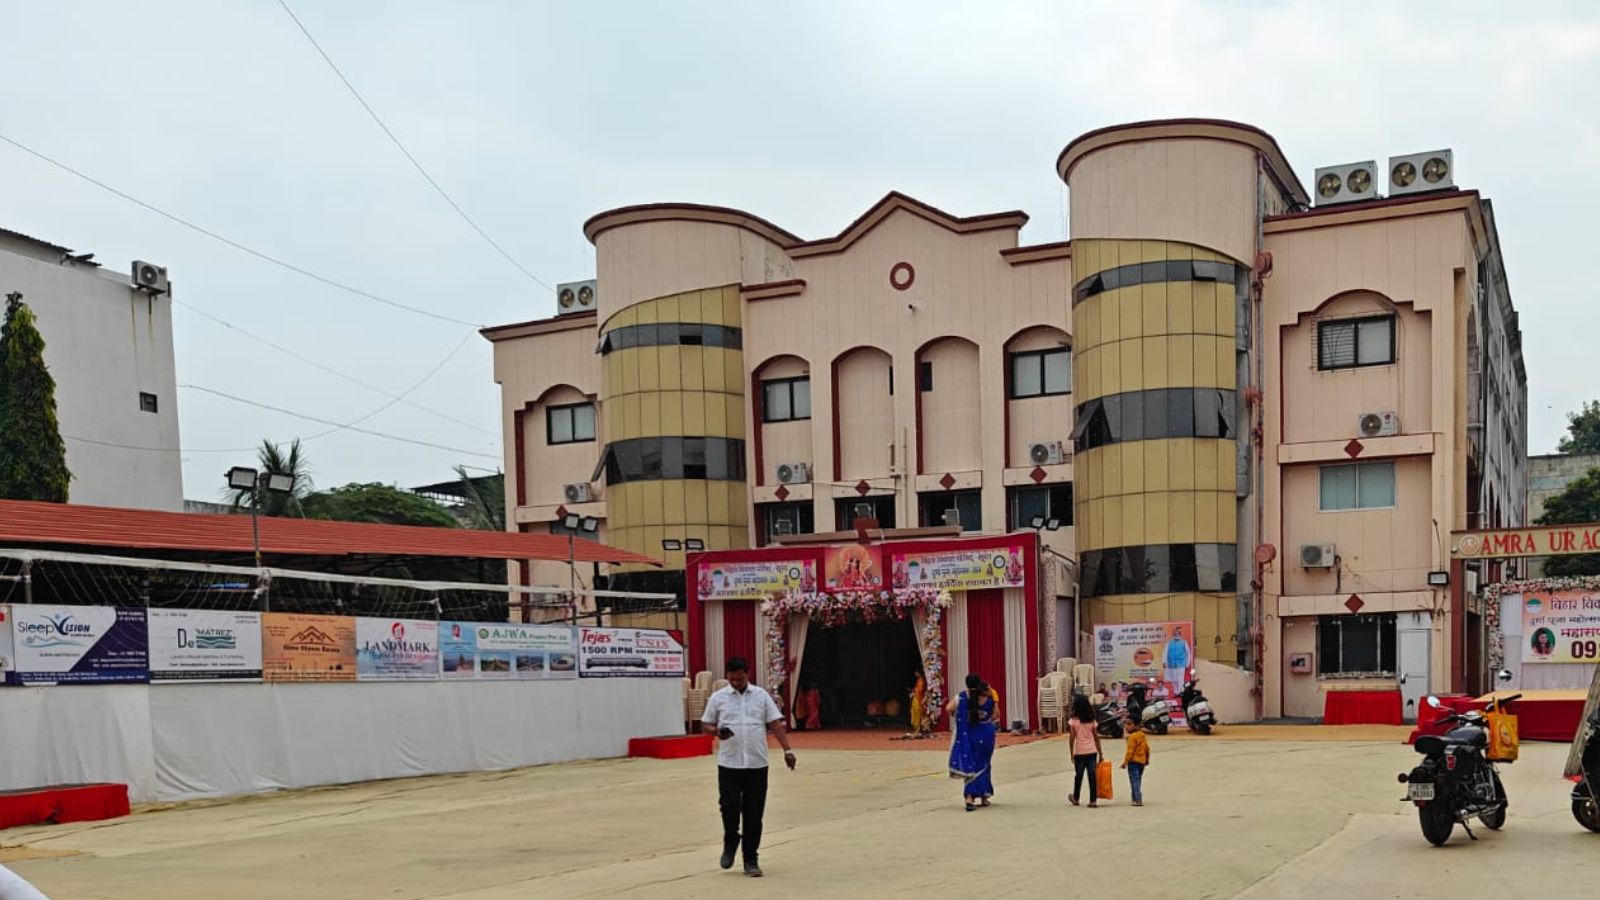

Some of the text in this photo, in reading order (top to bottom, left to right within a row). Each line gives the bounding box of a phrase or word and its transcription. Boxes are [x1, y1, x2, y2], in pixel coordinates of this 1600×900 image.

[1480, 532, 1536, 555] AMRA
[1551, 596, 1577, 610] बिहार
[582, 629, 612, 646] Tejas
[364, 639, 430, 653] LANDMARK
[582, 646, 608, 654] 1500
[610, 646, 633, 654] RPM
[1571, 640, 1597, 659] 09
